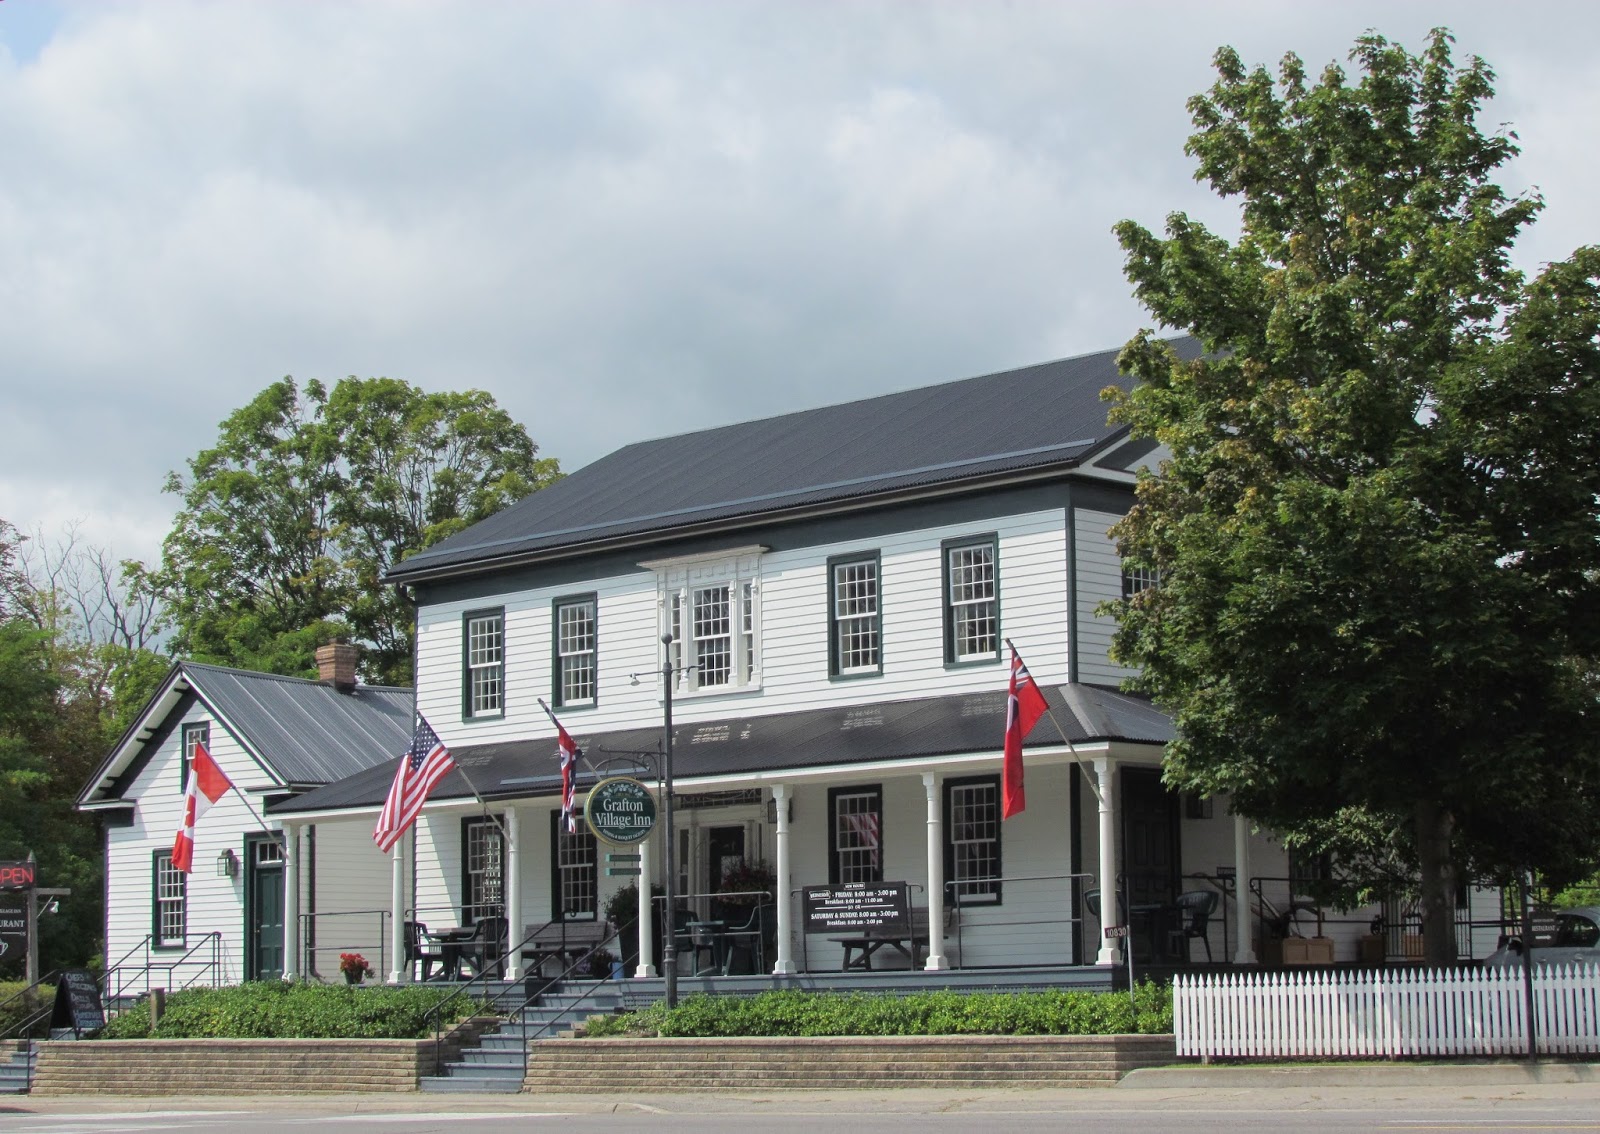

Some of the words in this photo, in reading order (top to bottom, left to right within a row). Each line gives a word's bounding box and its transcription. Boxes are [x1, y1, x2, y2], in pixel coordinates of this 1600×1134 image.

[603, 798, 643, 811] Grafton
[596, 813, 631, 829] Village
[634, 813, 651, 826] Inn
[0, 867, 33, 884] PEN
[811, 912, 834, 920] SATURDAY
